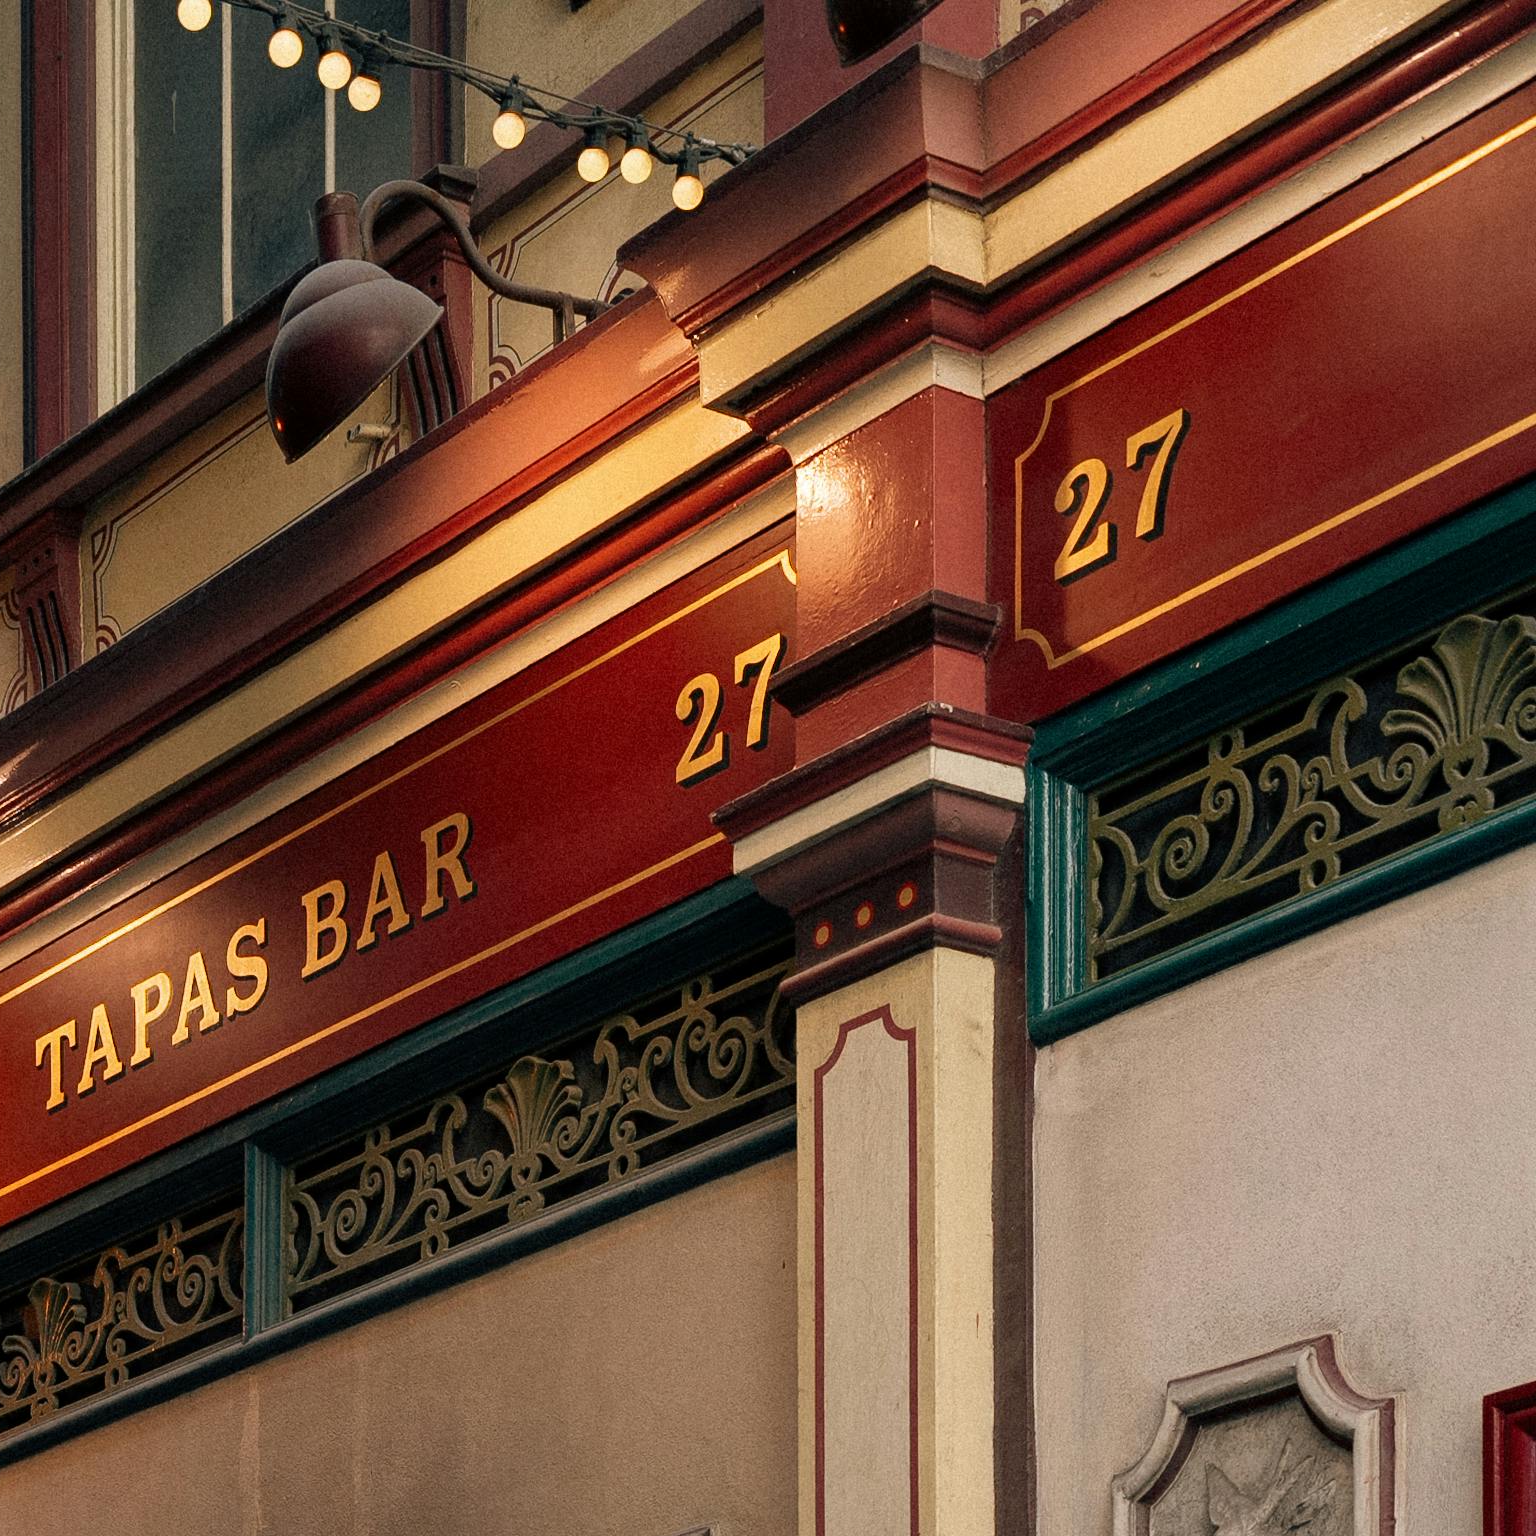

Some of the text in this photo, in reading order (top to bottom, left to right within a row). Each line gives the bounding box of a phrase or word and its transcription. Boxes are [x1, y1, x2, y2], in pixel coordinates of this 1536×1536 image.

[1054, 407, 1187, 583] 27
[675, 632, 784, 785] 27
[34, 811, 474, 1112] TAPAS BAR
